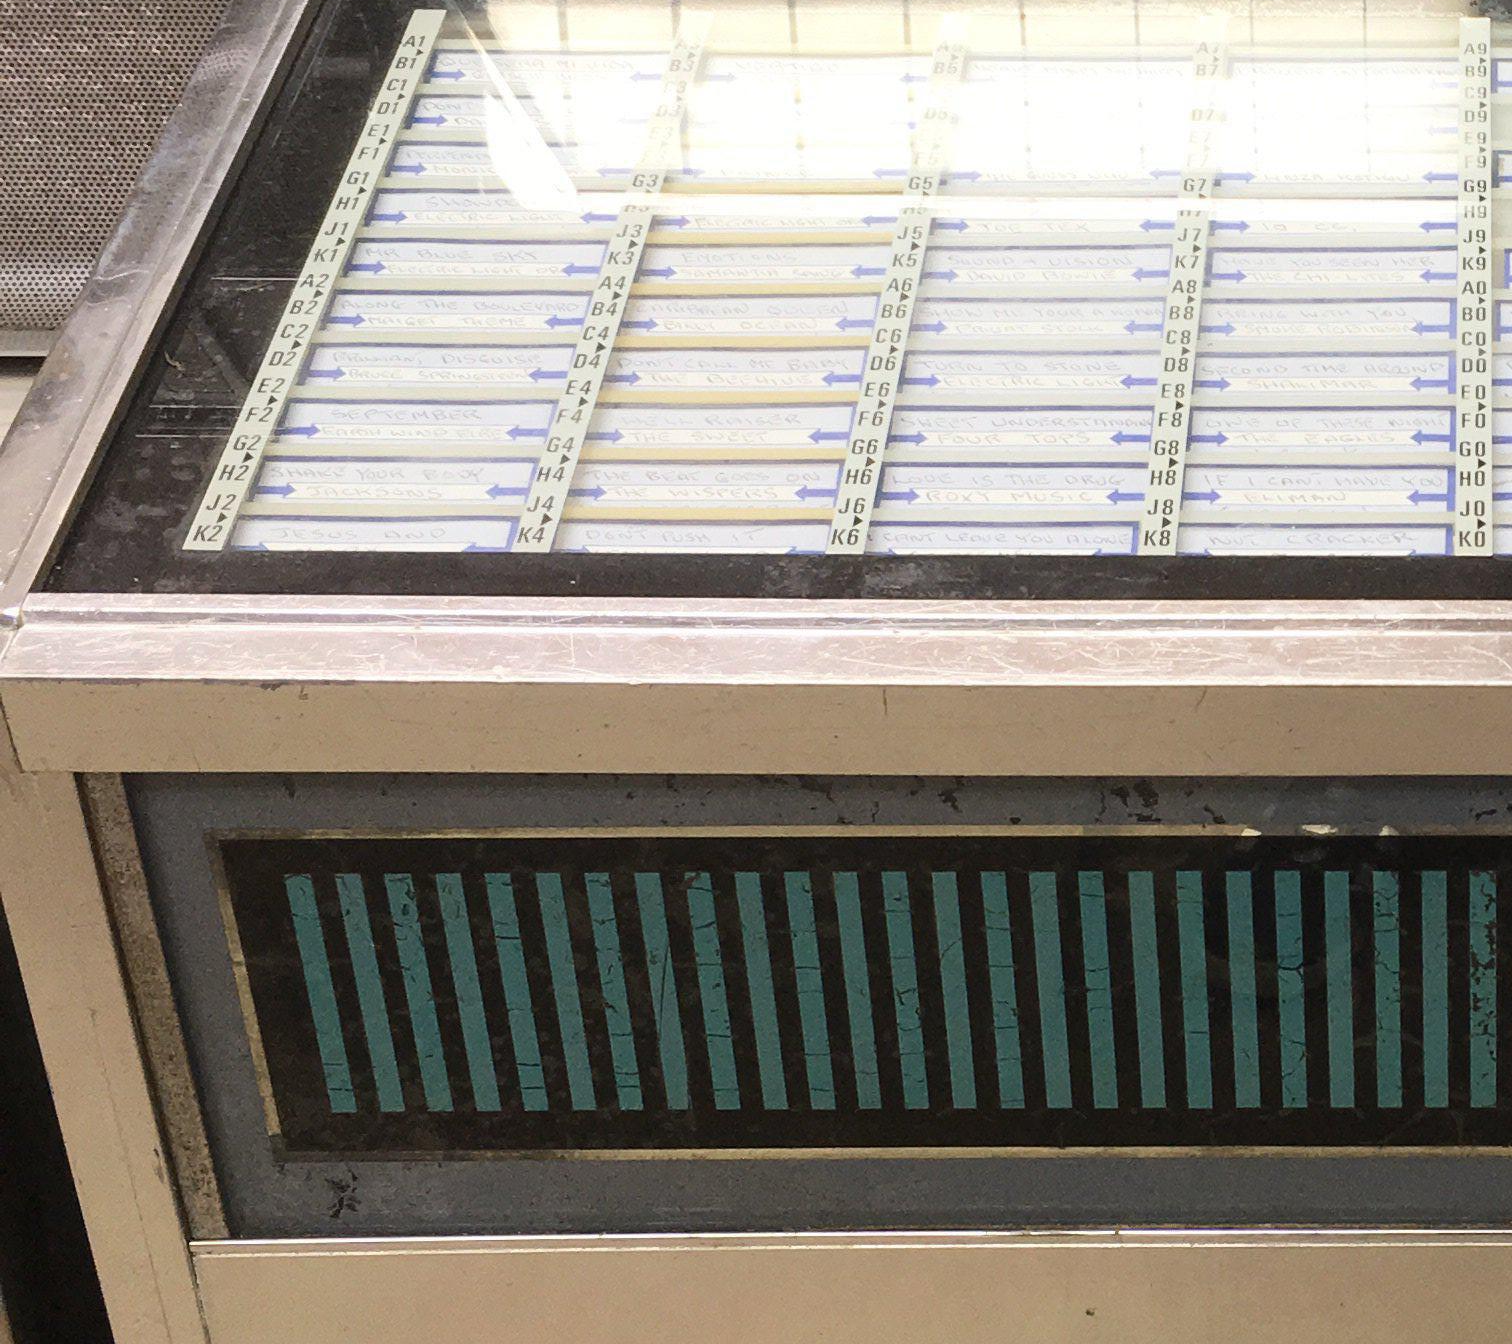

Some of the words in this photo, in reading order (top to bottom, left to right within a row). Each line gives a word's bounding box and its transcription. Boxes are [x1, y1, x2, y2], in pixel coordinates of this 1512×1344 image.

[405, 36, 425, 47] A1
[1464, 43, 1486, 54] A9
[396, 57, 416, 68] B1
[670, 59, 694, 71] B3
[1466, 66, 1486, 76] B9
[387, 80, 406, 90] C1
[377, 102, 398, 114] D1
[1465, 111, 1487, 122] D9
[368, 125, 389, 136] E1
[359, 148, 378, 159] F1
[347, 172, 368, 184] G1
[632, 175, 658, 187] G3
[909, 177, 932, 189] G5
[1184, 179, 1206, 191] G7
[1464, 180, 1486, 192] G9
[336, 197, 358, 209] H1
[1464, 206, 1486, 218] H9
[325, 223, 348, 235] J1
[617, 225, 642, 238] J3
[897, 227, 922, 239] J5
[1178, 228, 1201, 241] J7
[1463, 230, 1486, 243] J9
[314, 249, 337, 261] K1
[608, 251, 634, 264] K3
[893, 254, 916, 267] K5
[1175, 256, 1198, 268] K7
[1463, 257, 1486, 270] K9
[300, 274, 328, 288] A2
[599, 276, 625, 289] A4
[887, 279, 911, 291] A6
[1172, 280, 1196, 293] A8
[1462, 281, 1486, 294] A0
[290, 300, 317, 314] B2
[592, 302, 617, 316] B4
[881, 304, 907, 318] B6
[1170, 306, 1193, 320] B8
[1463, 307, 1486, 321] B0
[281, 324, 308, 338] C2
[583, 326, 609, 340] C4
[876, 329, 901, 343] C6
[1167, 330, 1190, 344] C8
[1462, 332, 1486, 346] C0
[269, 352, 296, 366] D2
[574, 354, 600, 368] D4
[871, 356, 895, 370] D6
[1164, 358, 1188, 372] D8
[1462, 359, 1486, 372] D0
[257, 378, 284, 392] E2
[566, 380, 591, 395] E4
[865, 383, 890, 397] E6
[1162, 384, 1185, 398] E8
[245, 407, 272, 422] F2
[557, 409, 582, 423] F4
[858, 411, 883, 426] F6
[1159, 413, 1182, 427] F8
[1462, 413, 1485, 428] F0
[234, 437, 261, 450] G2
[547, 437, 574, 452] G4
[852, 439, 878, 454] G6
[1154, 440, 1179, 455] G8
[1460, 442, 1485, 456] G0
[219, 465, 249, 480] H2
[537, 467, 564, 481] H4
[846, 469, 872, 484] H6
[1151, 470, 1176, 485] H8
[1460, 471, 1485, 486] H0
[207, 494, 236, 510] J2
[527, 496, 554, 512] J4
[839, 498, 865, 513] J6
[1148, 500, 1173, 515] J8
[1460, 501, 1484, 516] J0
[193, 526, 222, 541] K2
[517, 527, 544, 543] K4
[832, 529, 859, 545] K6
[1144, 530, 1170, 546] K8
[1460, 531, 1485, 547] K0
